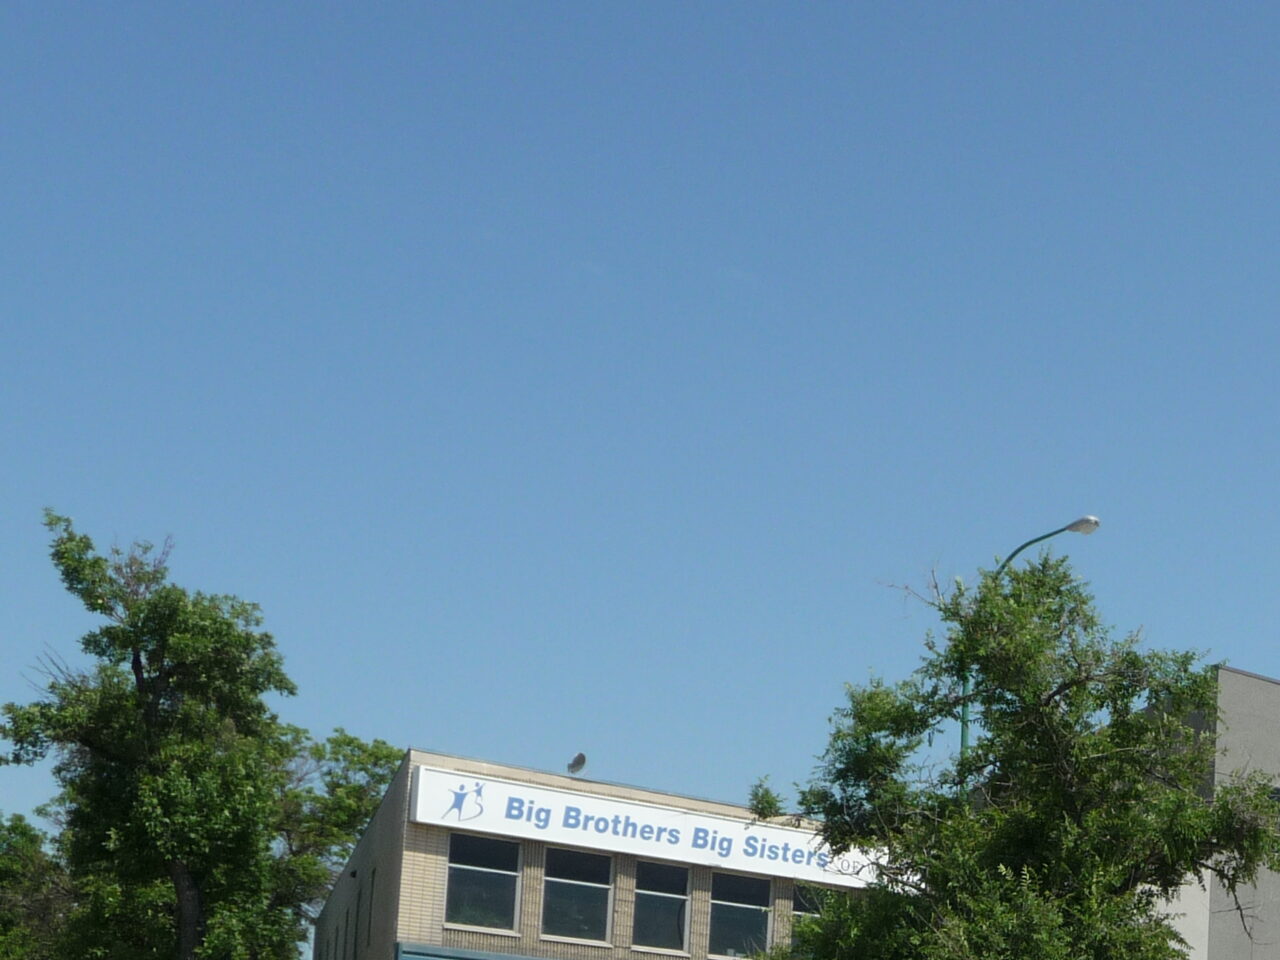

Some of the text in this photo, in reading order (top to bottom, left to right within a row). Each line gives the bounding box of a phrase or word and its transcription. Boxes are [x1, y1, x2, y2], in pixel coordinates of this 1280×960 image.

[505, 796, 552, 830] Big
[562, 805, 681, 845] Brothers
[691, 827, 734, 858] Big
[742, 835, 830, 868] Sisters
